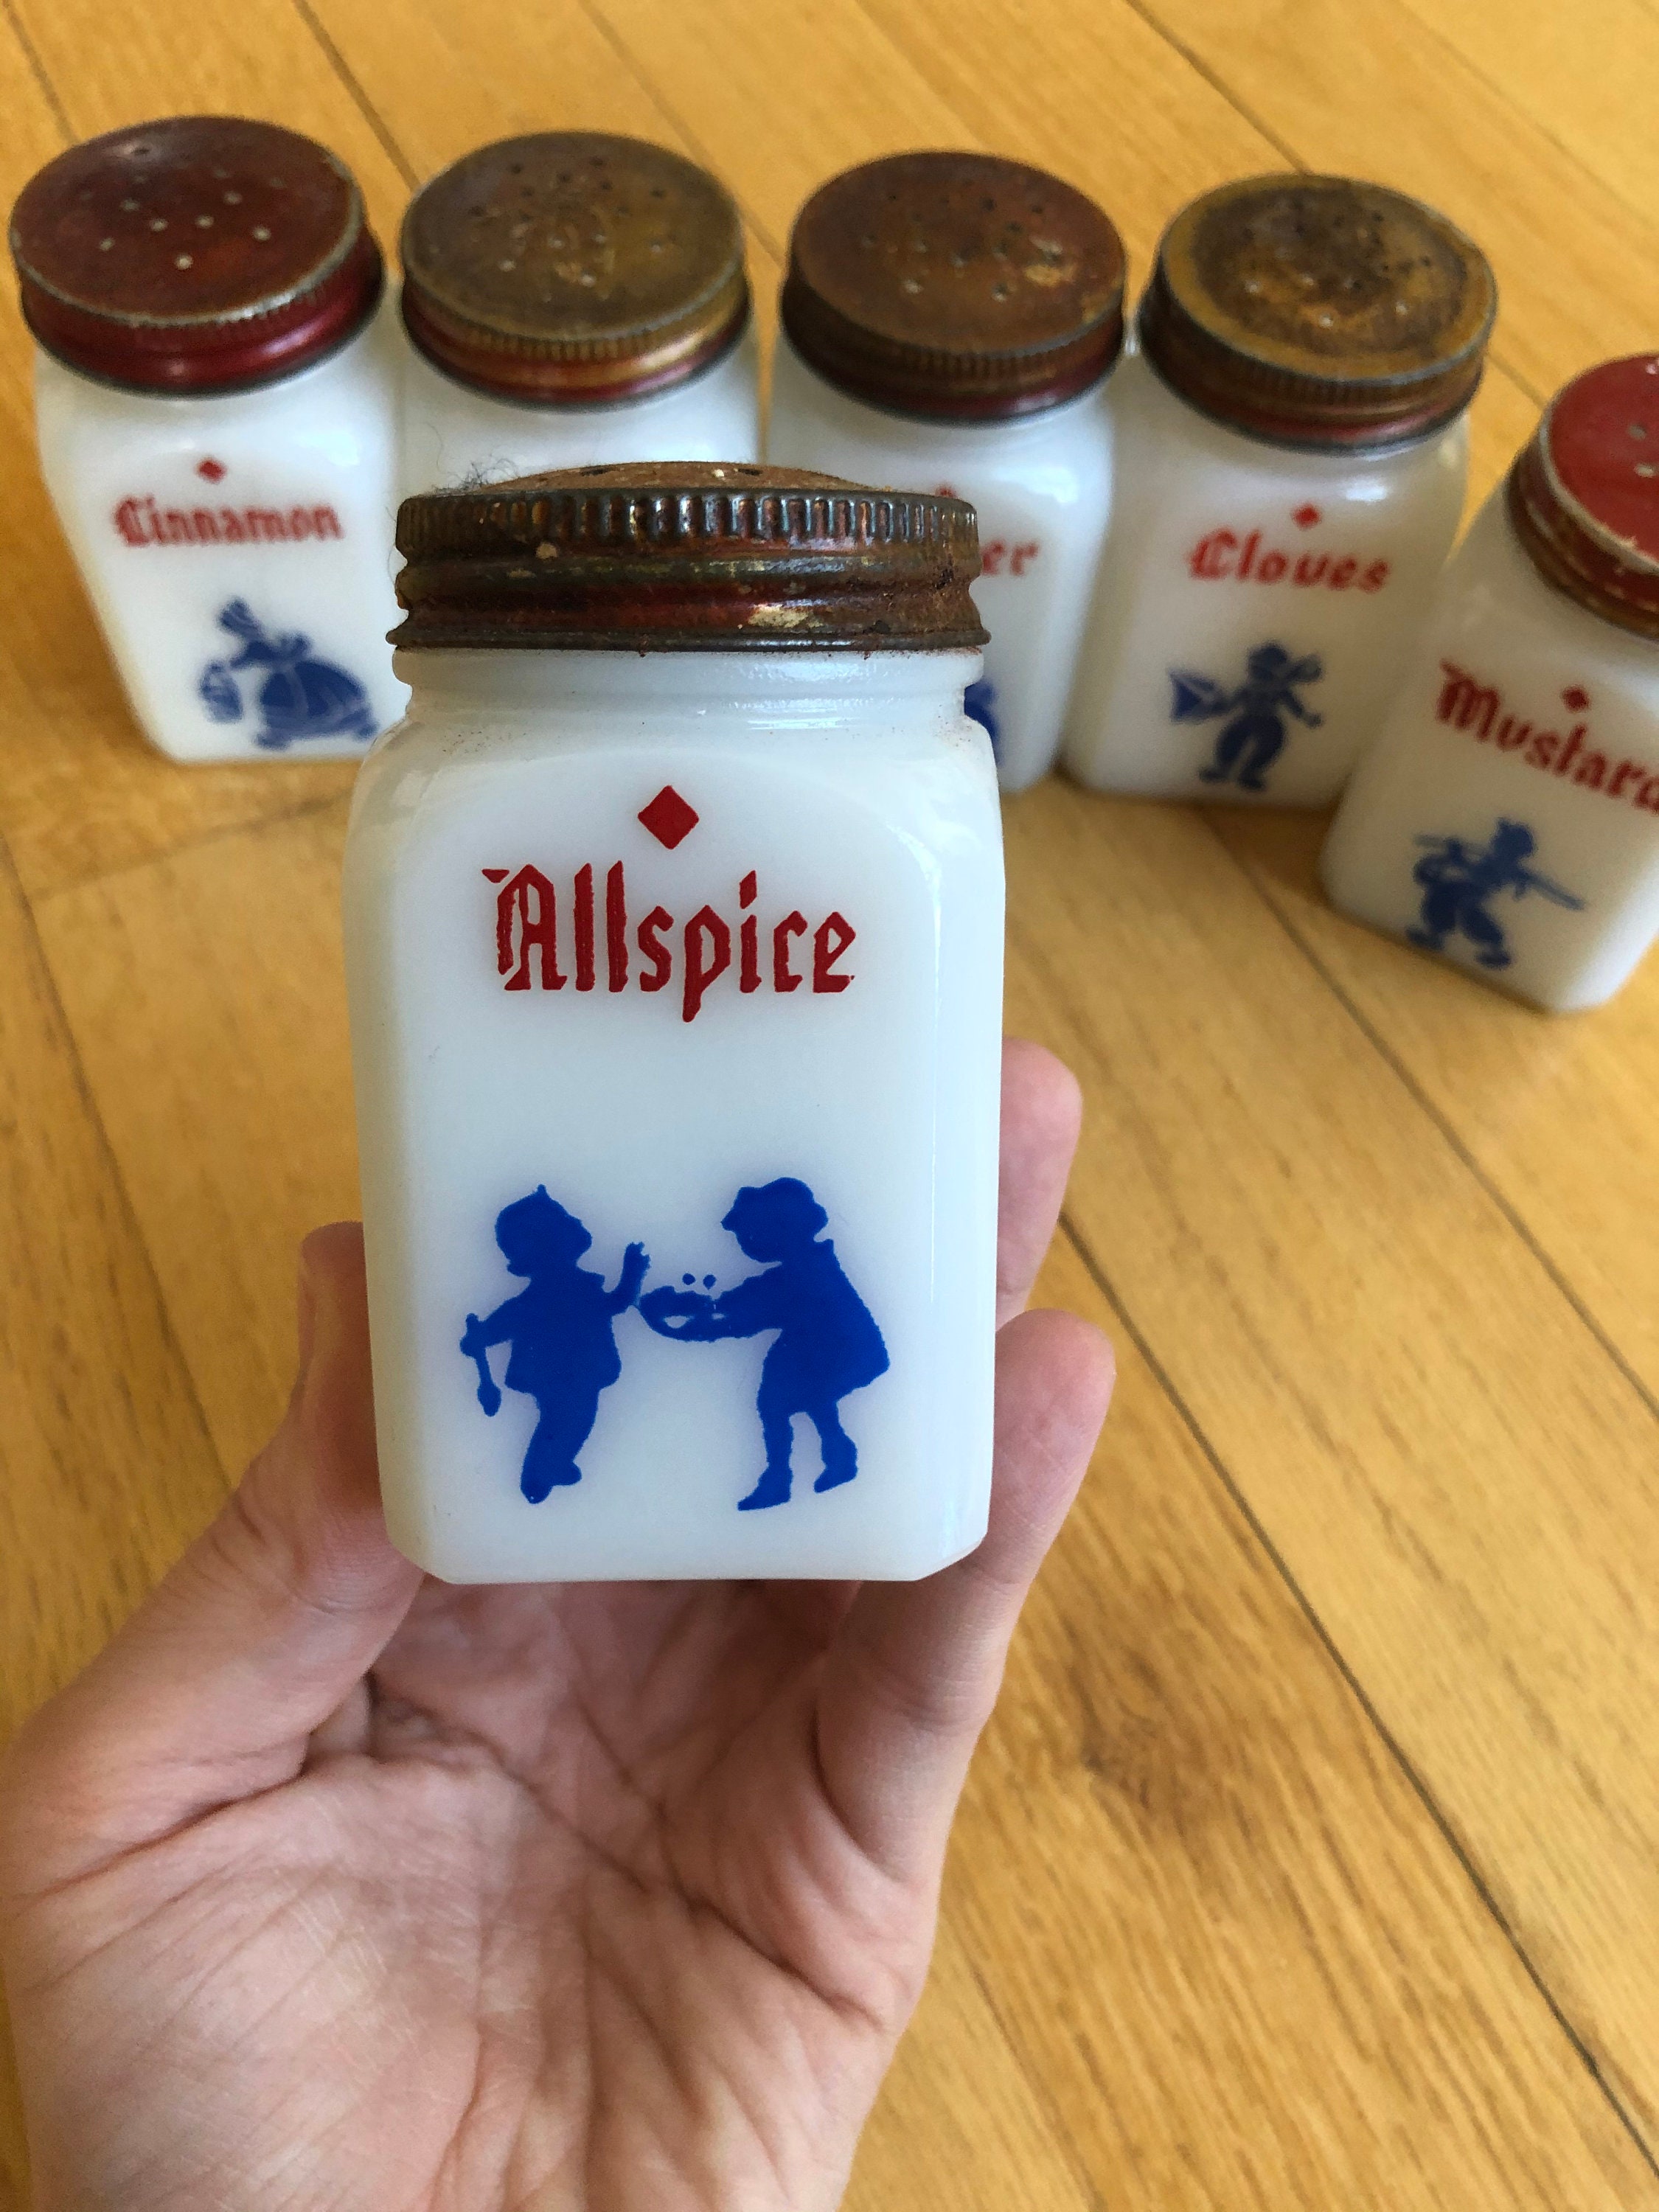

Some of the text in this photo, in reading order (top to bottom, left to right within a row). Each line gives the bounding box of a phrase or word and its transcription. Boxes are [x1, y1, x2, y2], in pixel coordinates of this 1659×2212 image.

[114, 495, 344, 548] Cinnamon
[1187, 526, 1392, 594] Cloves
[481, 860, 857, 1023] Allspice
